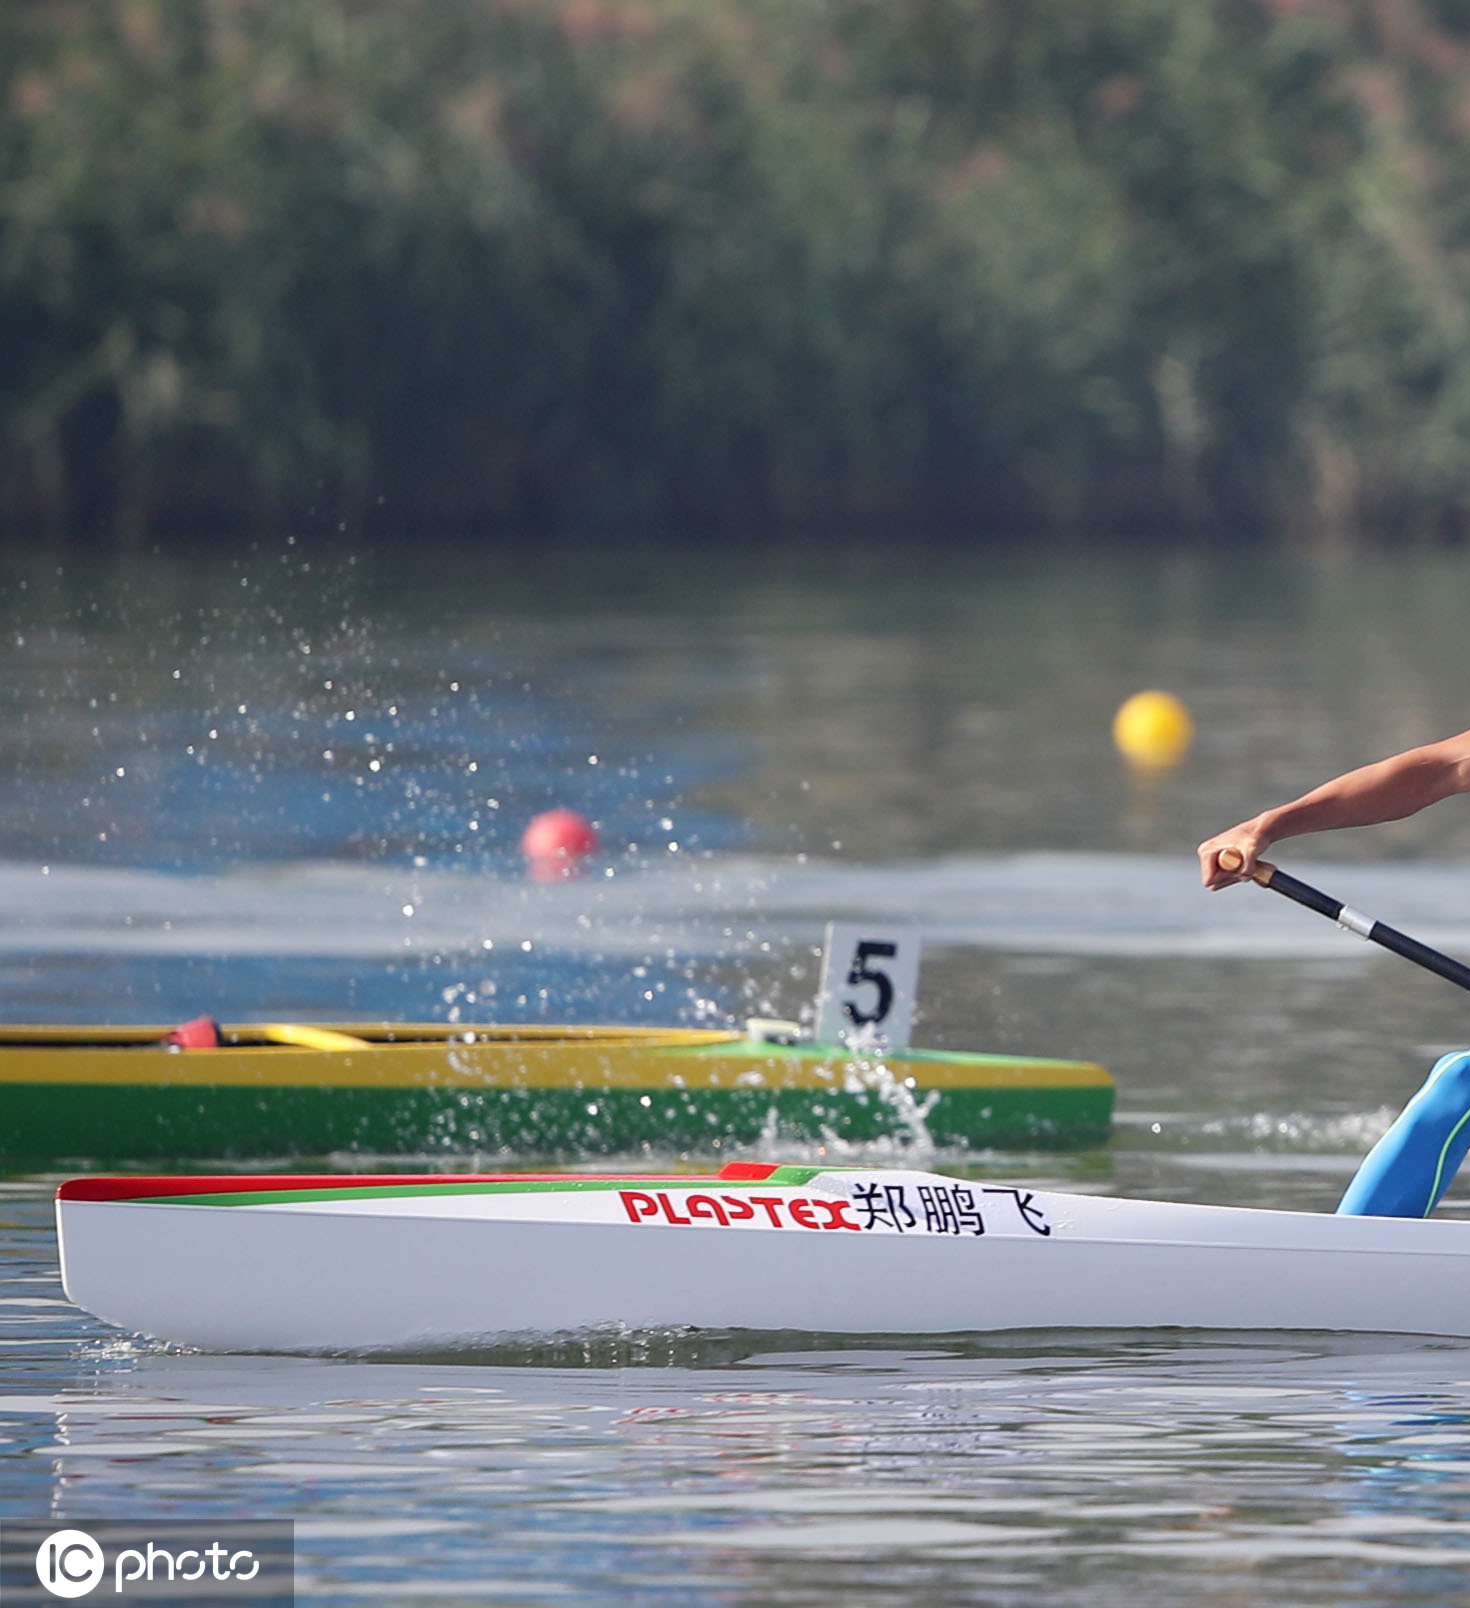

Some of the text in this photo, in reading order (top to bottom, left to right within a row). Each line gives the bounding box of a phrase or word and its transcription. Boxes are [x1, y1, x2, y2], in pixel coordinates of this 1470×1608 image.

[842, 941, 897, 1026] 5
[619, 1190, 862, 1231] PLASTEX
[852, 1182, 1051, 1237] 郑鹏飞
